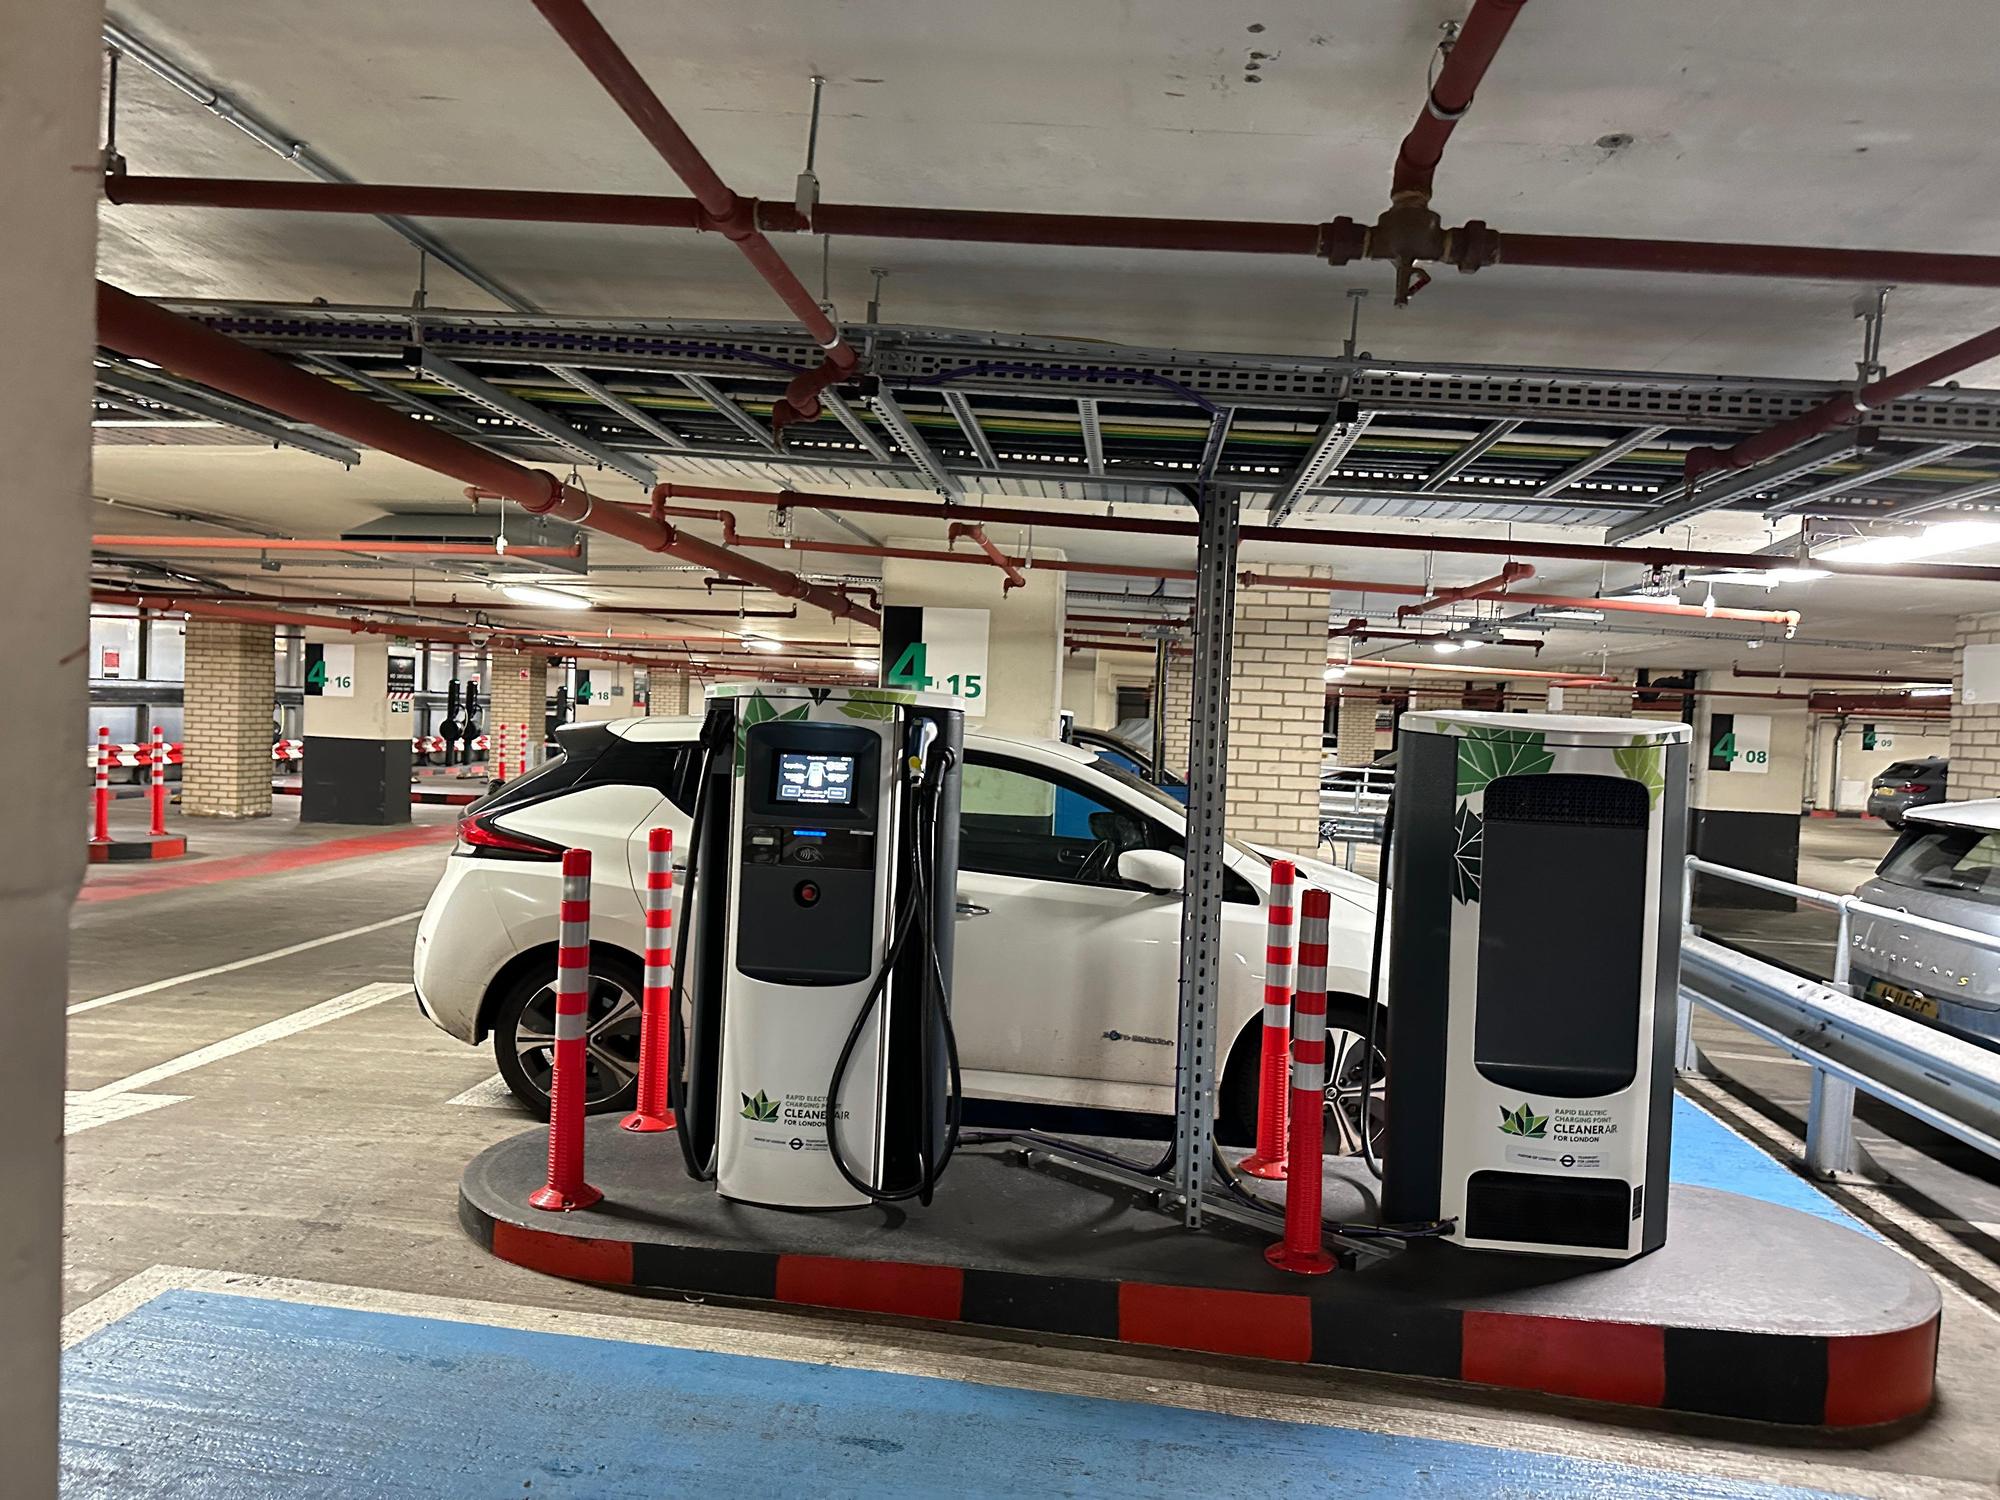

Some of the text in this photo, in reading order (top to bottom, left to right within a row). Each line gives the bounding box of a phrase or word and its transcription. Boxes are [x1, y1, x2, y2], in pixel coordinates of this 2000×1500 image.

[307, 660, 351, 688] 4 16
[888, 642, 982, 699] 4 15
[578, 681, 609, 700] 4 18
[1712, 732, 1767, 764] 4 08
[1881, 739, 1892, 747] 09
[785, 1100, 820, 1109] CHARGING
[784, 1108, 850, 1120] CLEANE AIR
[1554, 1108, 1577, 1116] RAPID
[1554, 1115, 1612, 1124] CHARGING POINT
[1553, 1123, 1605, 1135] CLEANER
[1553, 1134, 1568, 1142] FOR
